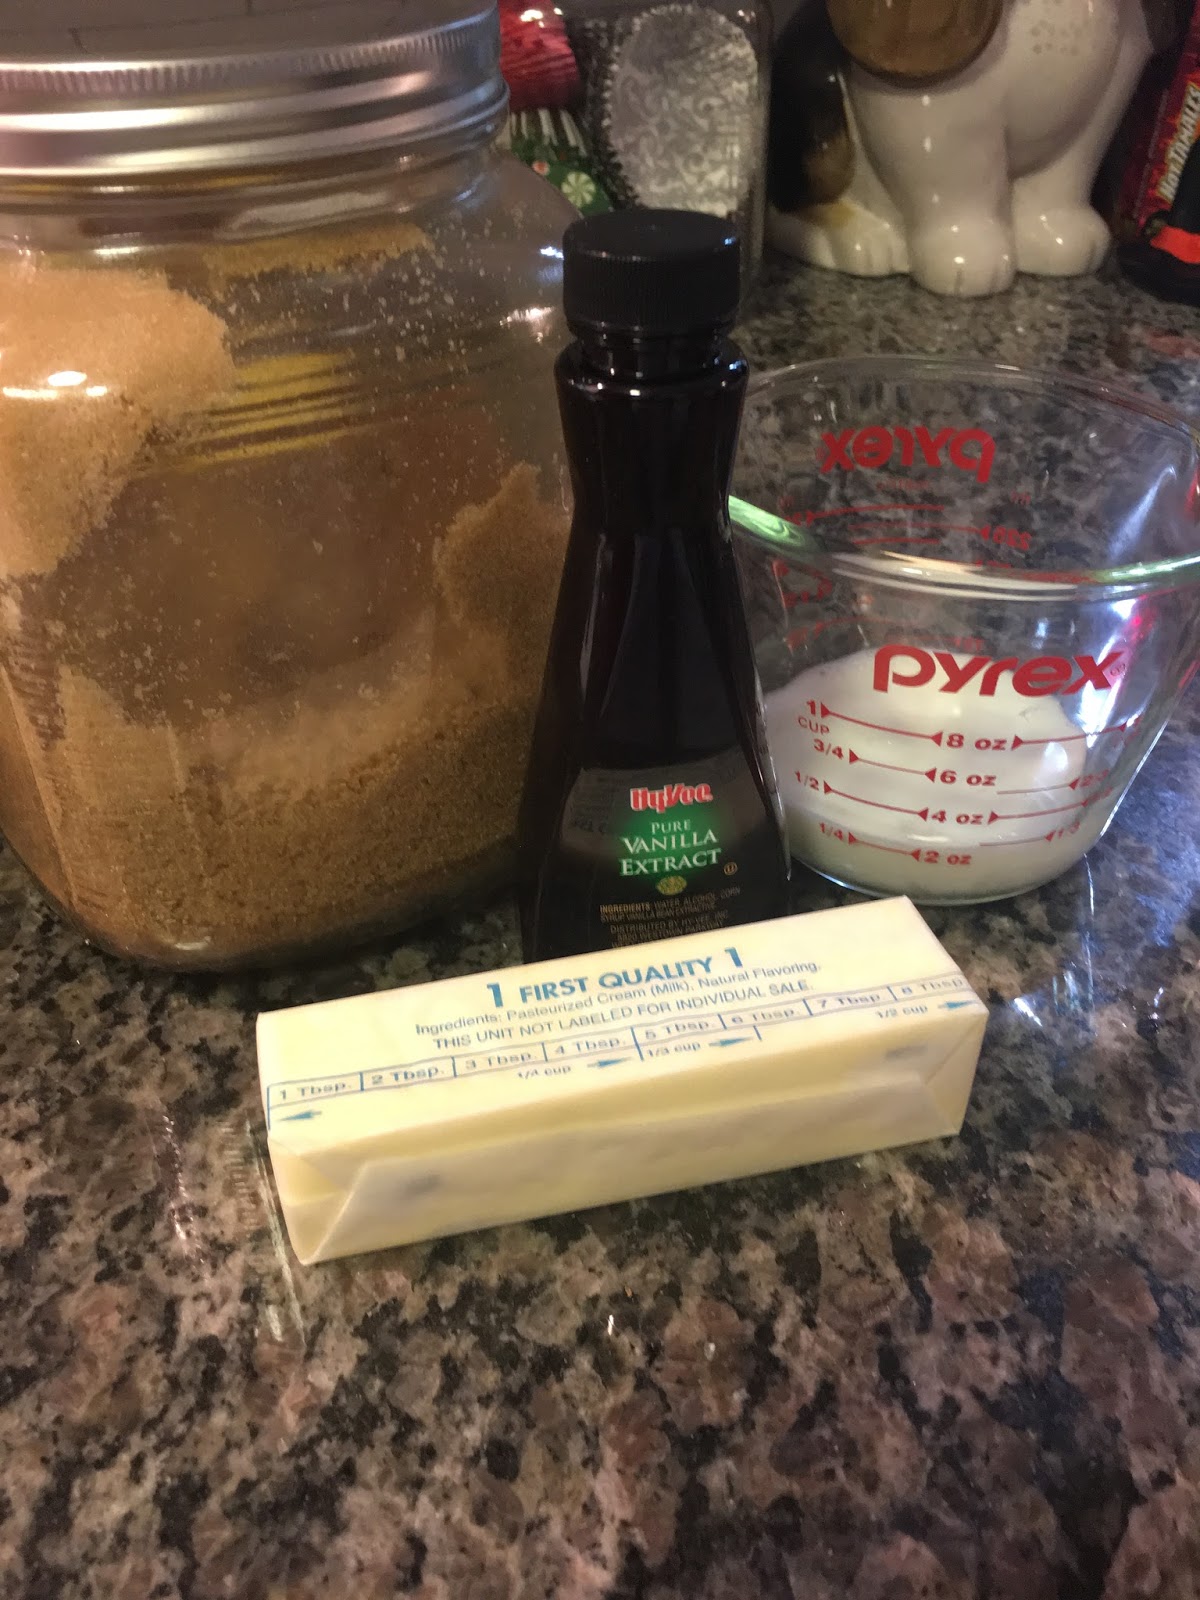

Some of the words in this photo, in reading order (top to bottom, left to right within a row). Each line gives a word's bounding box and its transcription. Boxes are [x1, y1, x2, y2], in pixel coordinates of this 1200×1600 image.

[873, 644, 1123, 697] pyrex
[806, 699, 817, 716] 1
[797, 716, 830, 734] CUP
[813, 738, 844, 760] 3/4
[946, 733, 965, 749] 8
[974, 737, 1008, 751] oz
[794, 769, 820, 791] 1/2
[939, 770, 958, 785] 6
[966, 774, 997, 787] oz
[931, 810, 947, 823] 4
[955, 813, 984, 825] oz
[651, 819, 691, 835] PURE
[819, 822, 844, 841] 1/4
[620, 829, 718, 854] VANILLA
[619, 849, 722, 876] EXTRACT
[924, 850, 940, 864] 2
[946, 854, 972, 865] oz
[486, 982, 503, 1008] 1
[519, 977, 588, 1004] FIRST
[598, 956, 713, 989] QUALITY
[724, 947, 743, 968] 1
[415, 1013, 502, 1036] Ingredients:
[506, 996, 593, 1021] Pasteurized
[597, 987, 646, 1004] Cream
[699, 971, 750, 989] Natural
[817, 999, 827, 1009] 7
[903, 1004, 928, 1016] cup
[433, 1033, 472, 1050] THIS
[477, 1027, 514, 1043] UNIT
[520, 1021, 553, 1037] NOT
[559, 1005, 633, 1030] LABELED
[637, 1001, 672, 1016] FOR
[677, 986, 767, 1011] INDIVIDUAL
[645, 1030, 656, 1040] 5
[555, 1045, 565, 1055] 4
[674, 1041, 702, 1054] cup
[465, 1059, 476, 1070] 3
[544, 1064, 572, 1077] cup
[371, 1074, 383, 1085] 2
[280, 1089, 287, 1100] 1
